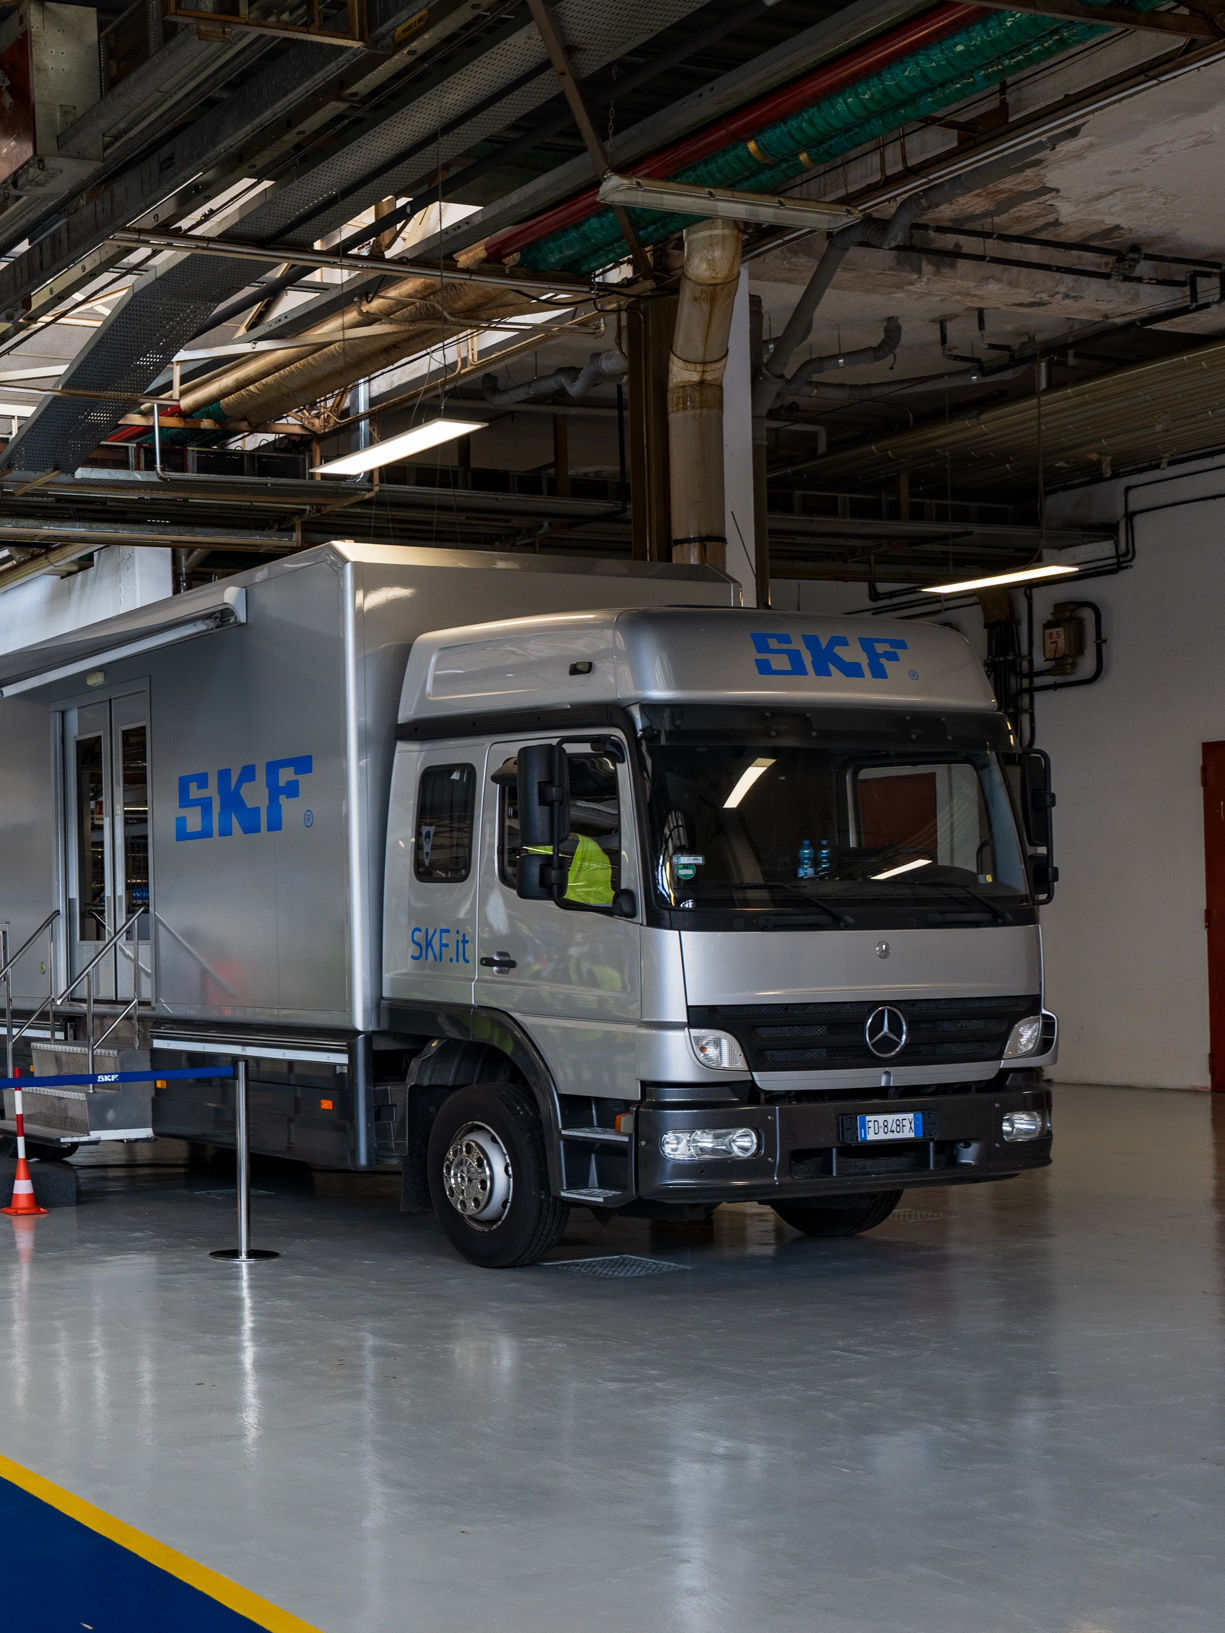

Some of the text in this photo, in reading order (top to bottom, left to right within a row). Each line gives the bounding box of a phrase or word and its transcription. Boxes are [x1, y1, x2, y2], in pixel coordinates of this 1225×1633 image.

[750, 632, 909, 679] SKF
[175, 754, 313, 842] SKF
[410, 927, 470, 964] SKF.it
[96, 1074, 119, 1082] SKF
